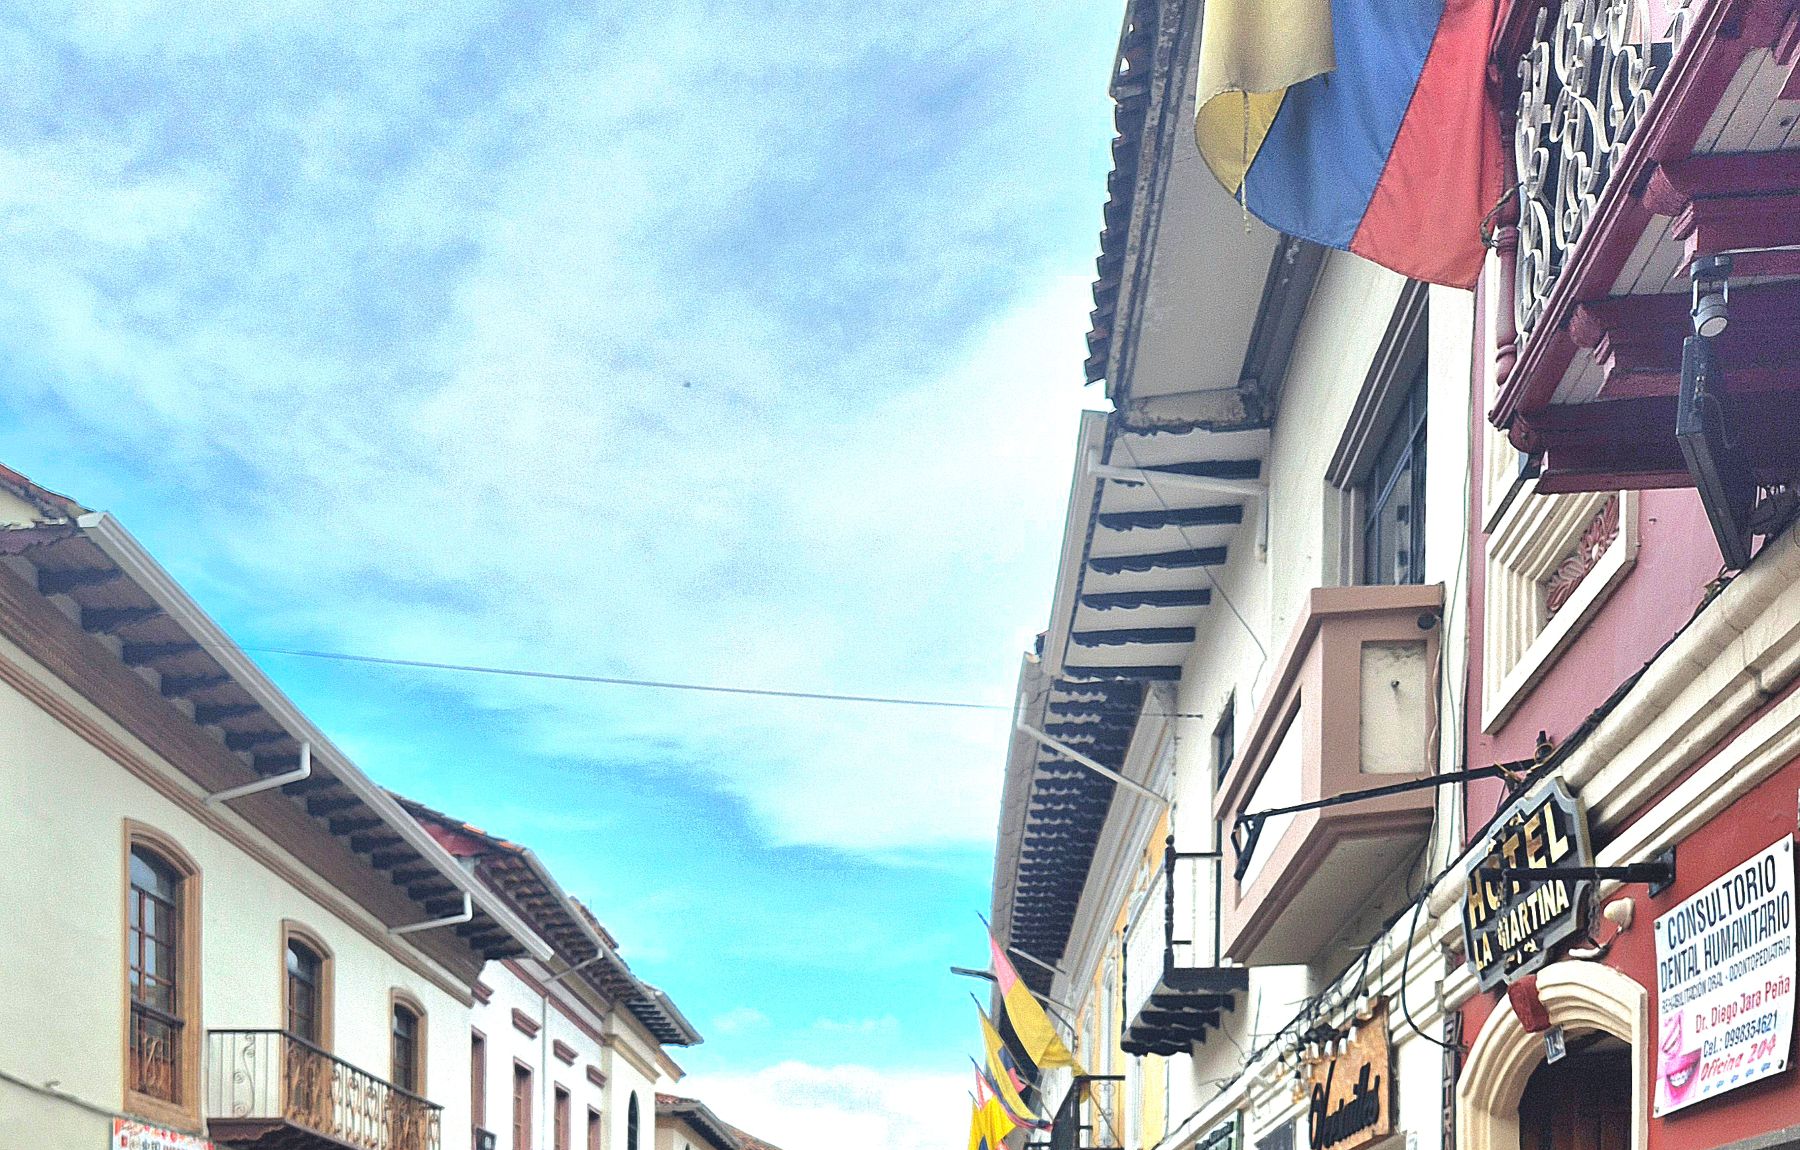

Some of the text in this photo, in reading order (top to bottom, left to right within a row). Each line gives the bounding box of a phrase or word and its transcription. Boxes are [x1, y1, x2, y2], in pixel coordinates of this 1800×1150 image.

[1474, 880, 1570, 972] LA MARTINA
[1660, 890, 1790, 993] DENTAL HUMANITARIO
[1667, 854, 1777, 950] CONSULTORIO
[1695, 975, 1791, 1034] Dr. Diego Jara Peña
